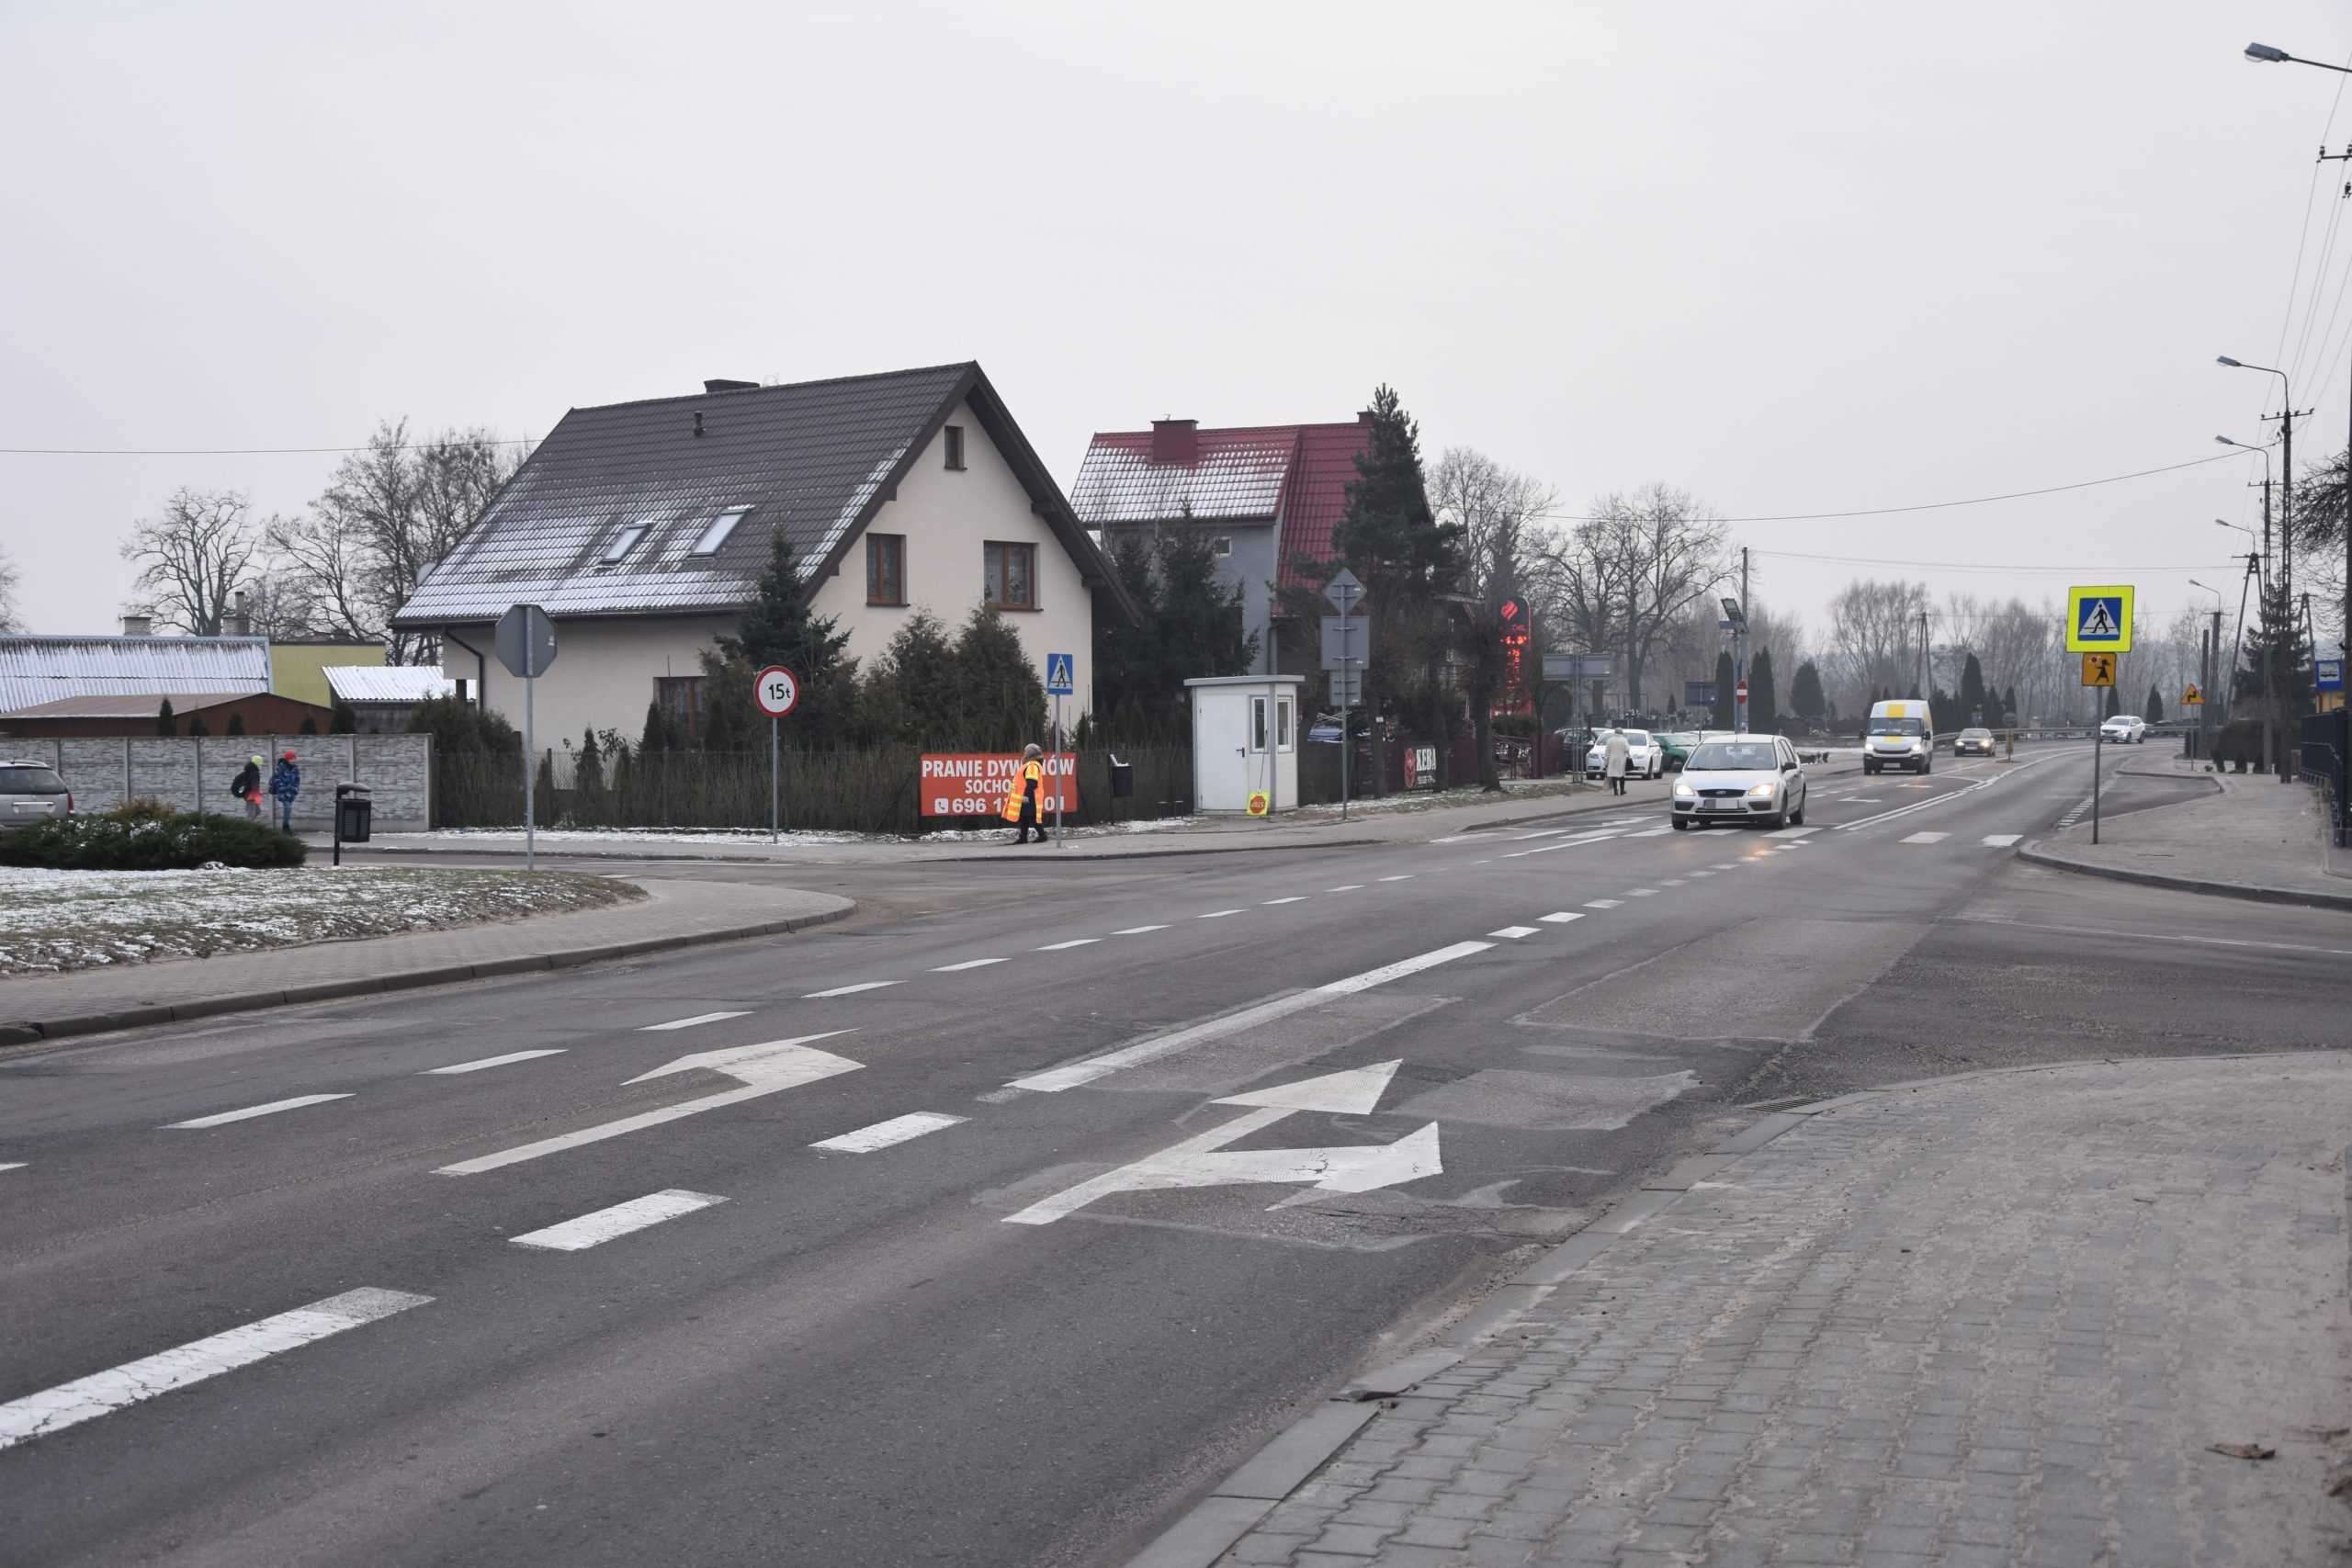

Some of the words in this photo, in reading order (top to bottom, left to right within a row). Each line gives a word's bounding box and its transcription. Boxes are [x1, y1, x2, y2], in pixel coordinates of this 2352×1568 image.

[1416, 748, 1437, 772] KEBA
[922, 760, 982, 778] PRANIE
[965, 779, 1012, 795] SOCHO
[952, 797, 986, 813] 696
